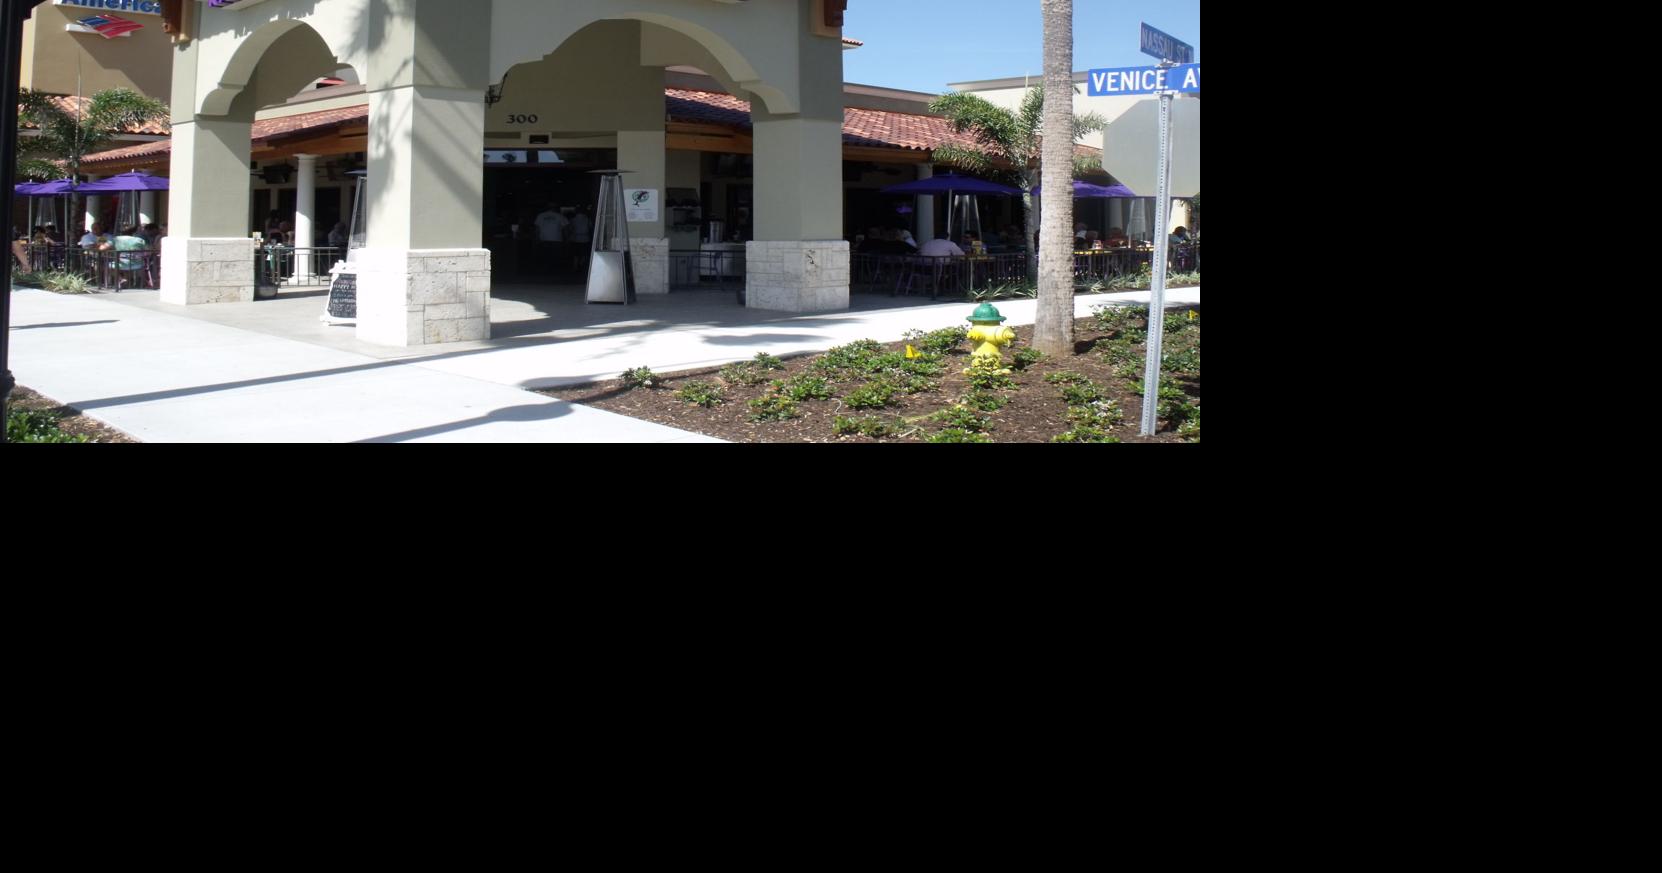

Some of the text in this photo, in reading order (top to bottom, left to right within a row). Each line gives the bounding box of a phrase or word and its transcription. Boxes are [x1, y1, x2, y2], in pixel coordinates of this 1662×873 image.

[1142, 27, 1173, 60] NASSAU
[1092, 67, 1200, 92] VENICE A
[506, 114, 538, 124] 300
